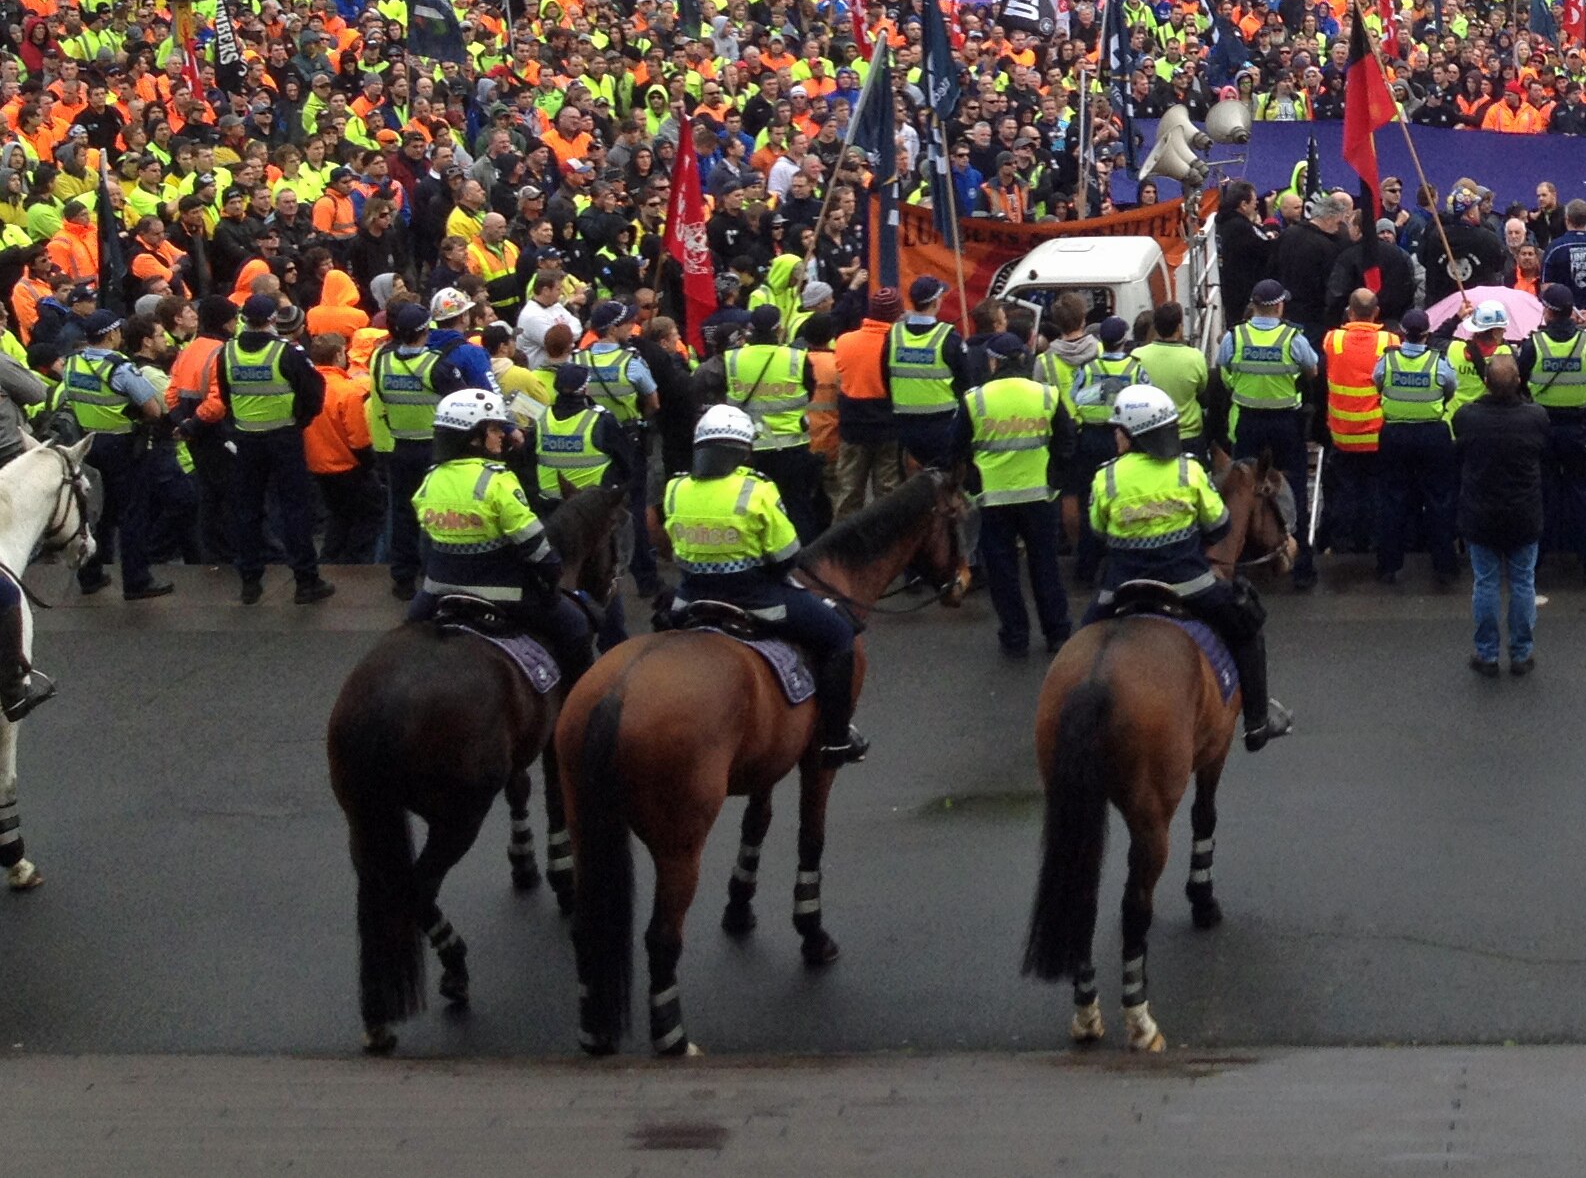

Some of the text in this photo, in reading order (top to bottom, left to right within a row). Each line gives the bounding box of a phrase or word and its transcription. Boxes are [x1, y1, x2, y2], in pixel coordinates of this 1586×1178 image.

[1244, 347, 1281, 360] Police
[233, 367, 271, 381] Police
[1392, 372, 1429, 386] Police
[384, 376, 422, 390] Police
[542, 436, 583, 452] Police
[424, 509, 483, 530] Police
[675, 523, 738, 546] Police
